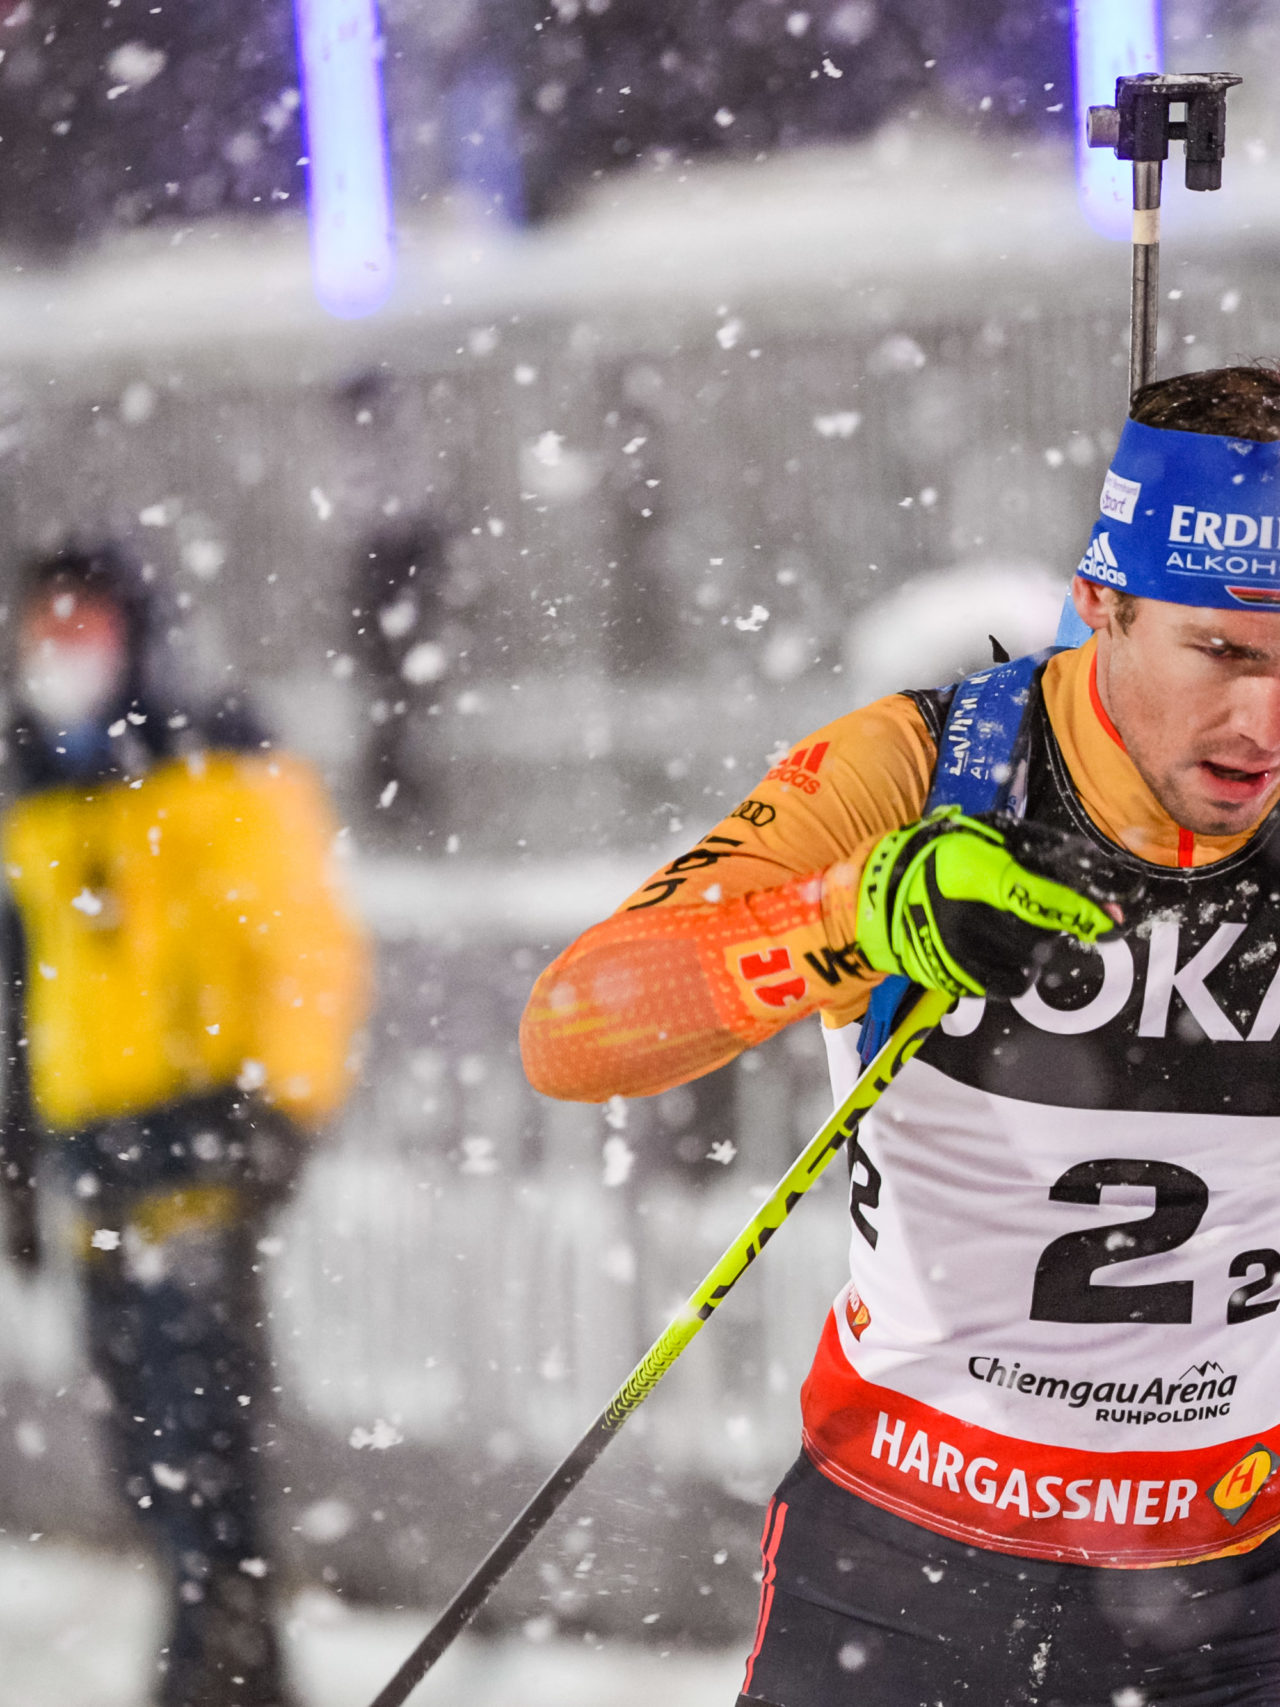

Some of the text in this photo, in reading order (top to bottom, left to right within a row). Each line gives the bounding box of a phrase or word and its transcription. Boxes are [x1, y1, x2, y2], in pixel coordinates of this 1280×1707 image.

[1029, 1157, 1210, 1325] 2
[870, 1411, 1198, 1526] HARGASSNER
[1095, 1402, 1231, 1425] RUHPOLDING
